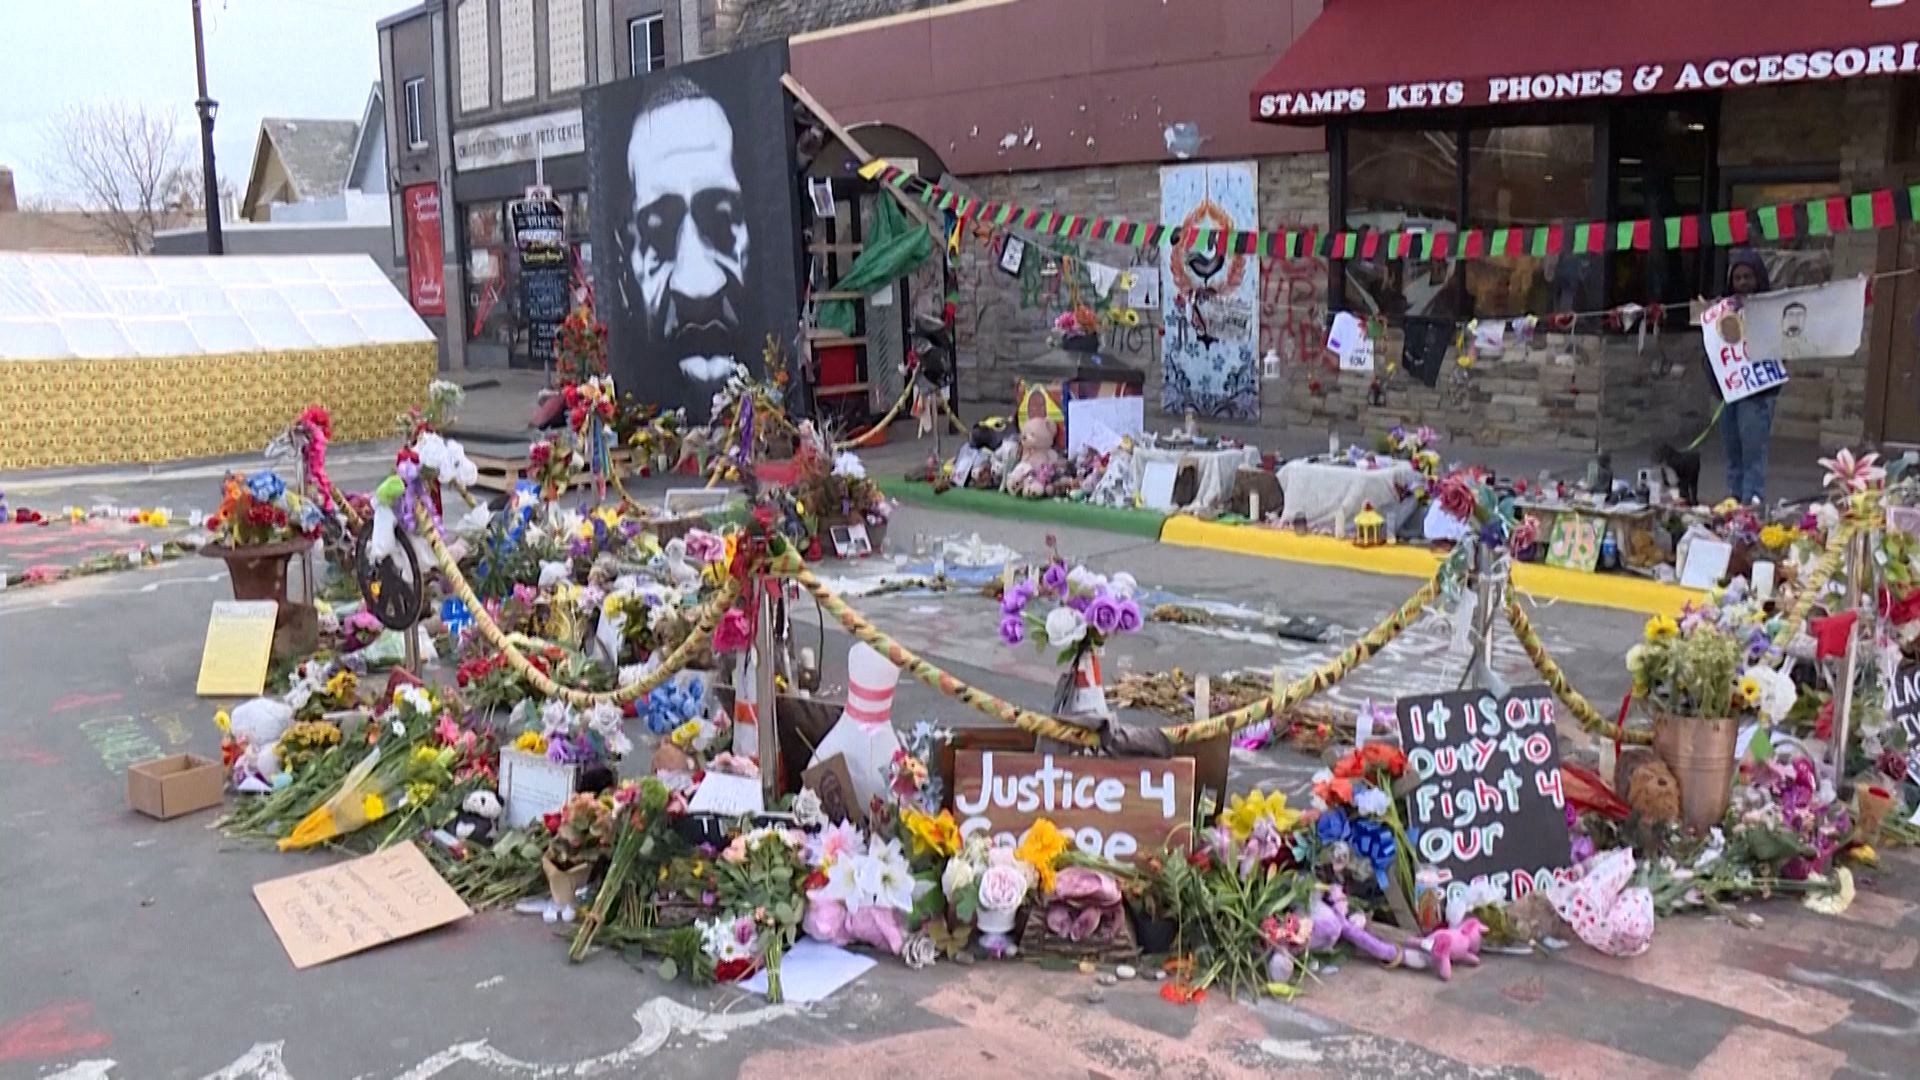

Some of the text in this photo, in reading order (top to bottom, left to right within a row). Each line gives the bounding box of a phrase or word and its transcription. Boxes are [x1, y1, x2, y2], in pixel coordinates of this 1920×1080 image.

[1259, 41, 1920, 117] STAMPS KEYS PHONES & ACCESSORI
[1725, 359, 1789, 391] IS REAL
[1409, 699, 1451, 742] It
[1504, 696, 1556, 729] OUR
[1500, 731, 1551, 764] to
[955, 751, 1177, 818] Justice 4
[1535, 767, 1566, 810] 4
[958, 816, 1138, 867] Gege
